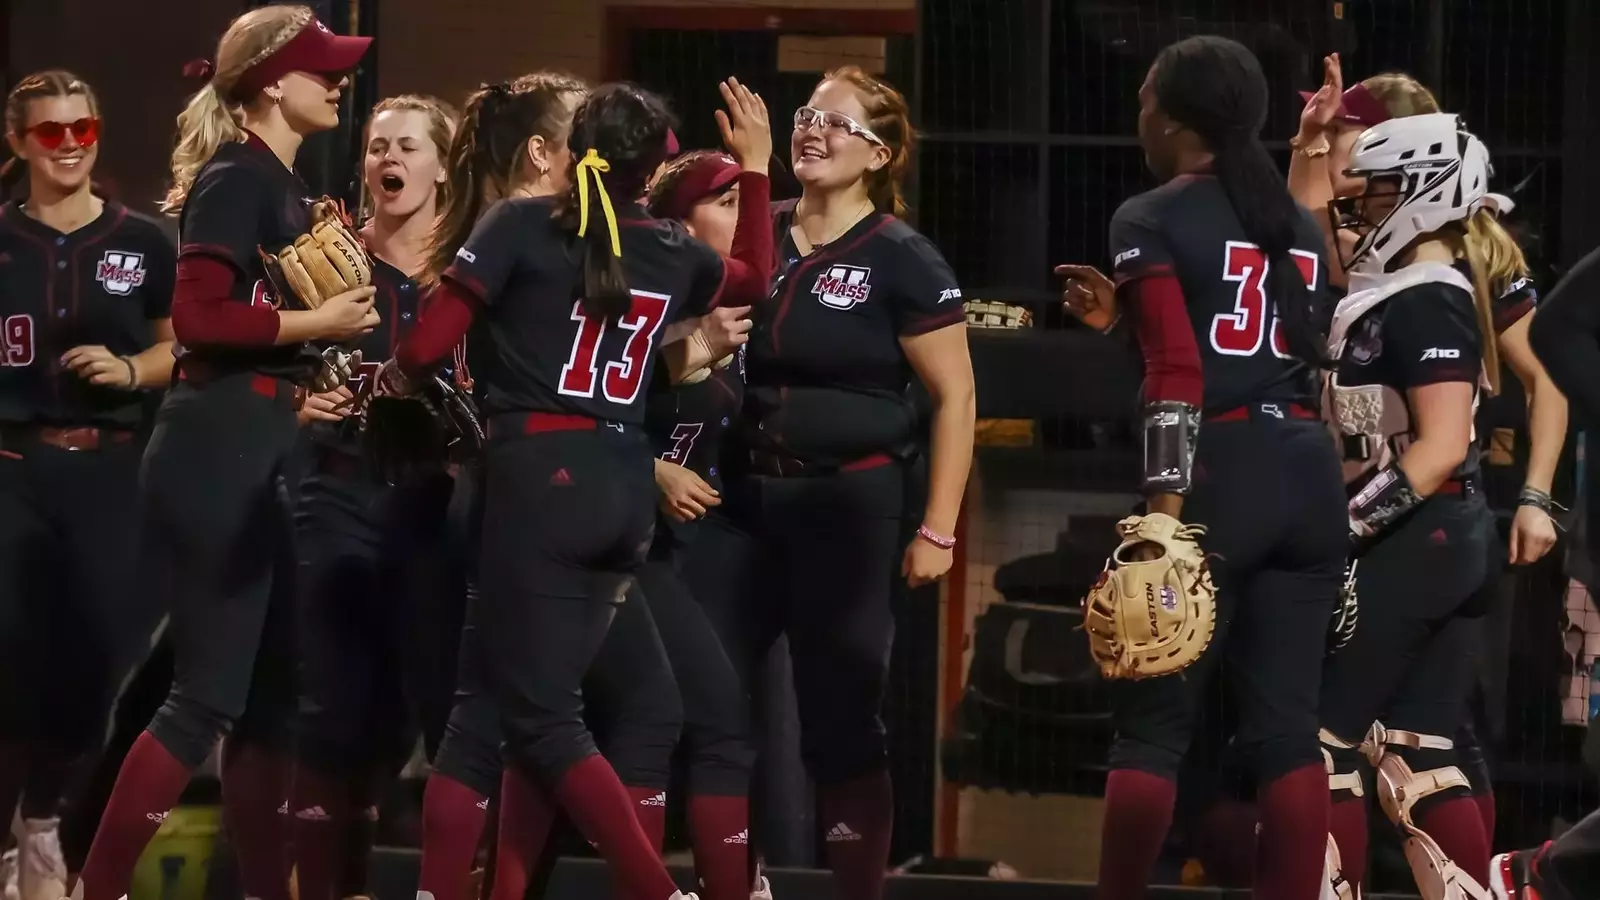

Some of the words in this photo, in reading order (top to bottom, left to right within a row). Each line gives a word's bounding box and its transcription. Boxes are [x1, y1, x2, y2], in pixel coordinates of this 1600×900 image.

[332, 240, 363, 285] EASTON
[814, 275, 868, 301] MASS
[557, 288, 672, 405] 13
[1419, 347, 1461, 361] A10
[660, 422, 704, 468] 3
[1145, 582, 1159, 638] EASTON
